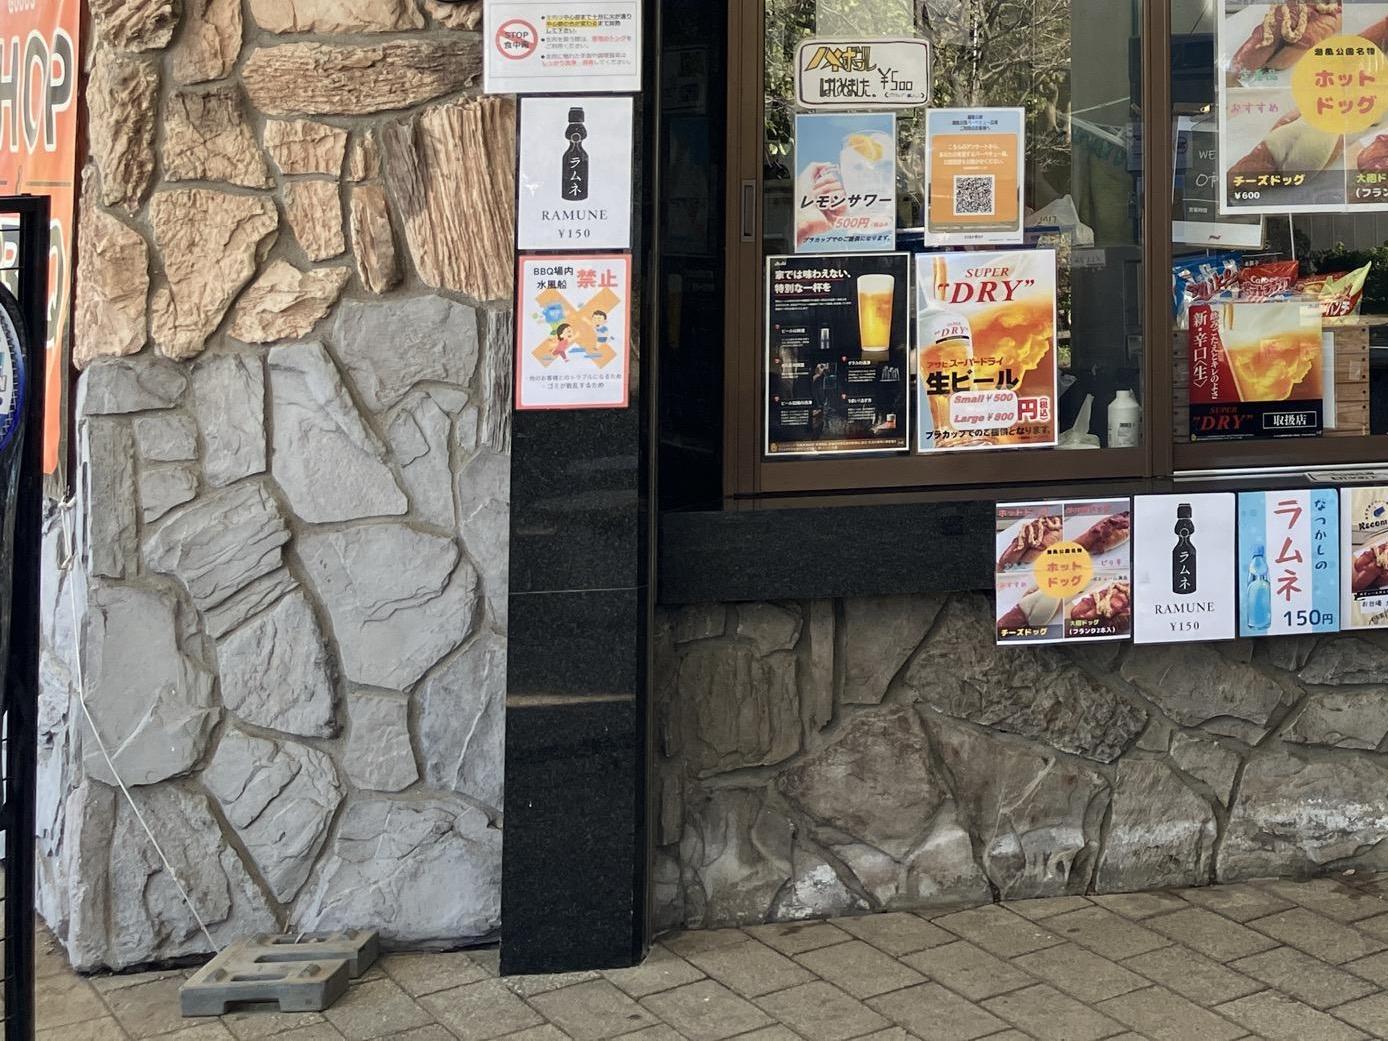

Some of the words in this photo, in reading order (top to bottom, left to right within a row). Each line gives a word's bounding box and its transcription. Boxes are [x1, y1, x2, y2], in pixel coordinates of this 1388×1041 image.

[505, 31, 529, 39] STOP
[877, 67, 913, 91] ¥500
[1314, 69, 1376, 87] ホット
[1231, 102, 1279, 113] おすすめ
[1316, 95, 1377, 115] ドッグ
[568, 157, 582, 196] ラムネ
[1233, 174, 1306, 187] チーズドッグ
[1234, 191, 1260, 199] ¥600
[800, 194, 892, 209] レモンサワー
[542, 210, 608, 220] RAMUNE
[834, 217, 870, 228] 500円
[533, 266, 574, 276] BBQ場内
[965, 267, 1009, 278] SUPER
[577, 269, 618, 288] 禁止
[775, 282, 832, 294] 特別な一杯を
[926, 369, 1019, 395] 生ビール
[954, 395, 985, 404] Small
[1017, 399, 1038, 420] 円
[954, 414, 985, 424] Large
[1273, 414, 1307, 426] 取扱店
[1314, 499, 1327, 570] なつかしの
[1273, 499, 1303, 602] ラムネ
[1047, 561, 1083, 571] ホット
[1179, 550, 1190, 589] ラムネ
[1048, 575, 1083, 588] ドッグ
[1155, 602, 1215, 614] RAMUNE
[1283, 609, 1334, 627] 150円
[1001, 627, 1047, 637] チーズドッグ
